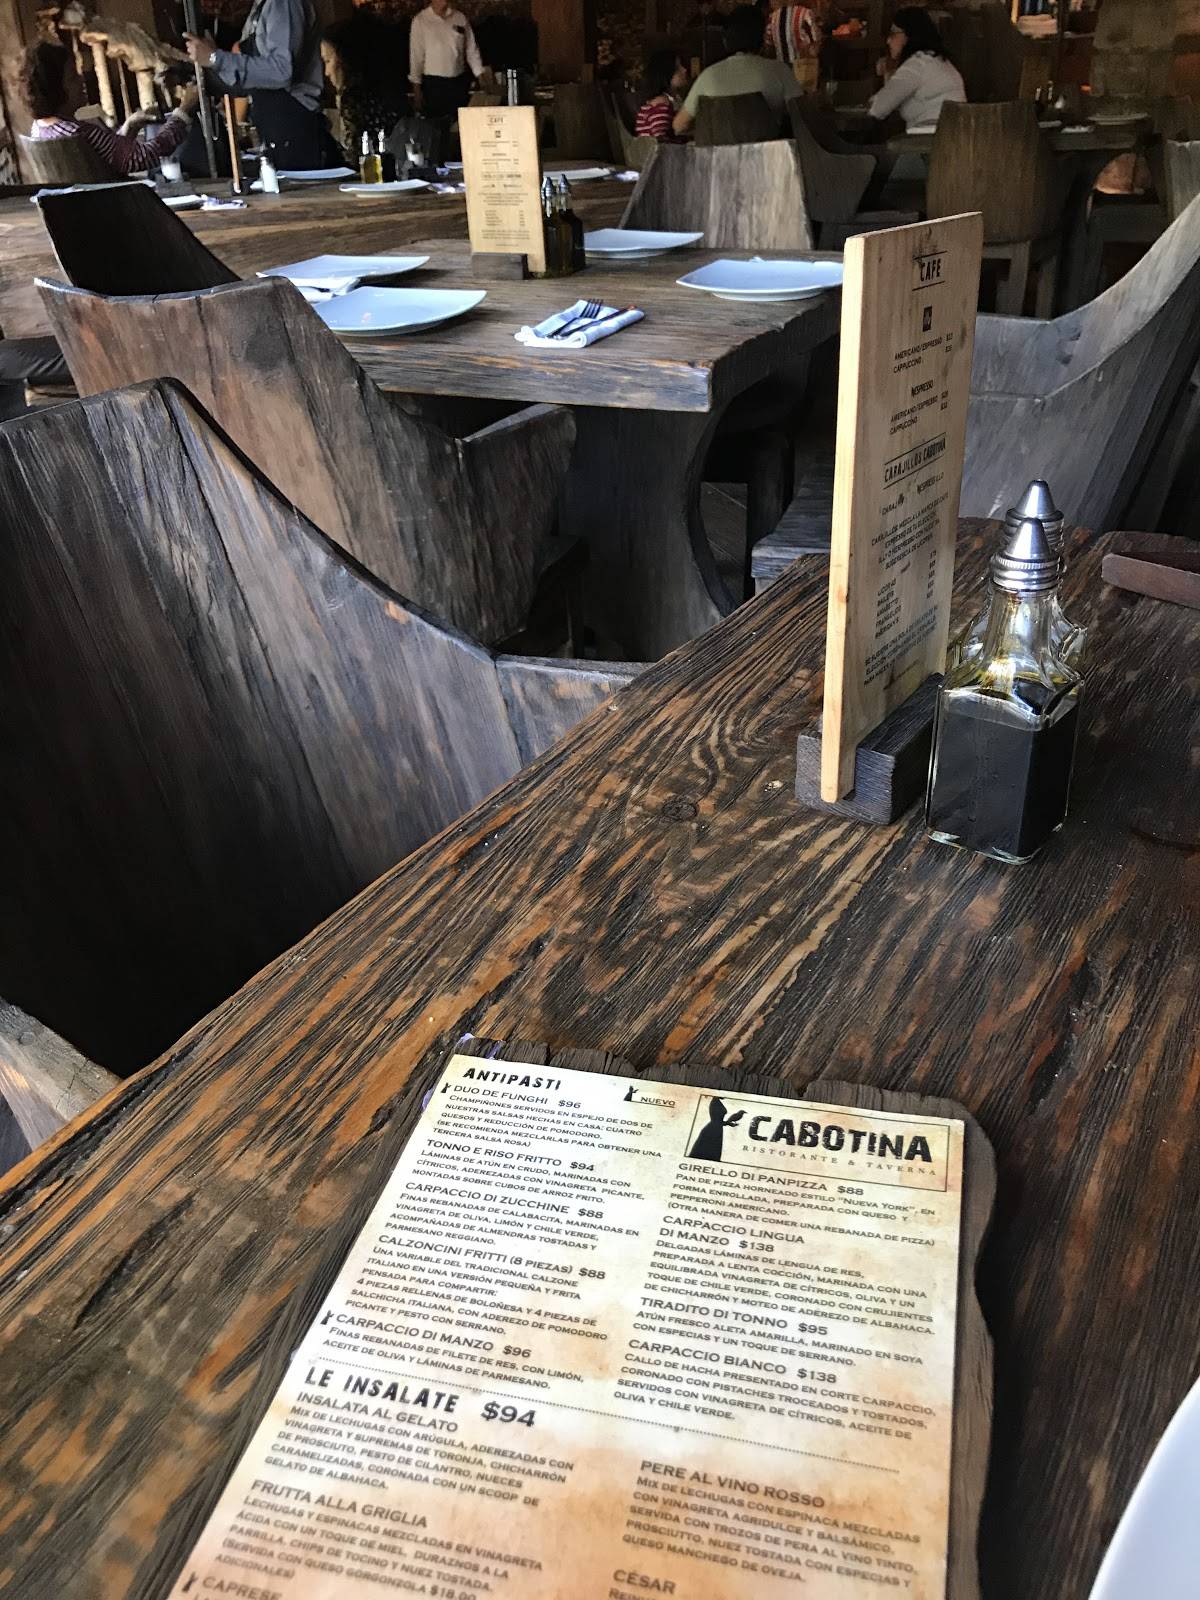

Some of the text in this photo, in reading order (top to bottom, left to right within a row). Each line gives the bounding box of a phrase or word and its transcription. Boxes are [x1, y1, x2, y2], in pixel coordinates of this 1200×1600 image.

[919, 257, 941, 282] CAFE
[884, 453, 922, 483] CARAJILLOS
[463, 1067, 560, 1089] ANTIPASTI
[453, 1085, 581, 1109] DUO DE FUNGHI $96
[639, 1096, 675, 1106] NUEVO
[513, 1104, 555, 1114] SERVIDOS
[571, 1112, 604, 1121] ESPEJO
[619, 1119, 639, 1127] DOS
[433, 1127, 472, 1138] TERCERA
[474, 1134, 501, 1143] SALSA
[749, 1116, 931, 1162] CABOTINA
[427, 1139, 594, 1171] TONNO E RISO FRITTO $94
[742, 1144, 837, 1164] RISTORANTE
[866, 1161, 936, 1175] TAVERNA
[411, 1168, 460, 1181] MONTADAS
[462, 1176, 493, 1186] SOBRE
[494, 1181, 525, 1191] CUBOS
[541, 1188, 574, 1198] ARROZ
[575, 1193, 605, 1203] FRITO.
[678, 1162, 864, 1196] GIRELLO DI PANPIZZA $88
[697, 1177, 711, 1185] DE
[713, 1179, 741, 1189] PIZZA
[742, 1184, 799, 1197] HORNEADO
[800, 1192, 835, 1202] ESTILO
[405, 1182, 603, 1219] CARPACCIO DI ZUCCHINE $88
[670, 1192, 789, 1215] PEPPERONI AMERICANO.
[384, 1222, 497, 1245] PARMESANO REGGIANO.
[659, 1227, 774, 1252] DI MANZO $138
[662, 1215, 804, 1244] CARPACCIO LINGUA
[378, 1234, 462, 1255] CALZONCINI
[463, 1248, 507, 1262] FRITTI
[578, 1267, 606, 1279] $88
[396, 1251, 441, 1264] VARIABLE
[443, 1258, 461, 1268] DEL
[465, 1262, 528, 1278] TRADICIONAL
[531, 1273, 578, 1287] CALZONE
[713, 1249, 759, 1262] LÁMINAS
[760, 1256, 776, 1265] DE
[777, 1259, 821, 1271] LENGUA
[822, 1266, 838, 1274] DE
[840, 1268, 864, 1278] RES,
[361, 1267, 497, 1296] PENSADA PARA COMPARTIR:
[641, 1296, 828, 1336] TIRADITO DI TONNO $95
[336, 1314, 531, 1358] CARPACCIO DI MANZO $96
[667, 1316, 711, 1329] FRESCO
[712, 1323, 746, 1335] ALETA
[749, 1329, 808, 1346] AMARILLA,
[811, 1340, 872, 1356] MARINADO
[874, 1350, 891, 1359] EN
[893, 1353, 923, 1365] SOYA
[628, 1339, 837, 1384] CARPACCIO BIANCO $138
[296, 1392, 458, 1433] INSALATA AL GELATO
[304, 1366, 535, 1427] LE INSALATE $94
[613, 1391, 735, 1420] OLIVA Y CHILE VERDE.
[264, 1456, 388, 1489] GELATO DE ALBAHACA.
[640, 1460, 825, 1508] PERE AL VINO ROSSO
[250, 1479, 427, 1528] FRUTTA ALLA GRIGLIA
[660, 1482, 678, 1493] DE
[746, 1501, 775, 1514] CON
[775, 1507, 839, 1528] ESPINACA
[842, 1521, 920, 1544] MEZCLADAS
[306, 1510, 315, 1520] Y
[315, 1513, 380, 1534] ESPINACAS
[381, 1528, 453, 1551] MEZCLADAS
[454, 1543, 473, 1555] EN
[475, 1547, 542, 1571] VINAGRETA
[622, 1534, 664, 1550] QUESO
[666, 1544, 738, 1567] MANCHEGO
[740, 1559, 758, 1572] DE
[289, 1539, 324, 1554] CHIPS
[325, 1546, 343, 1558] DE
[345, 1550, 389, 1570] TOCINO
[391, 1560, 399, 1570] Y
[400, 1563, 433, 1579] NUEZ
[613, 1569, 676, 1594] CÉSAR
